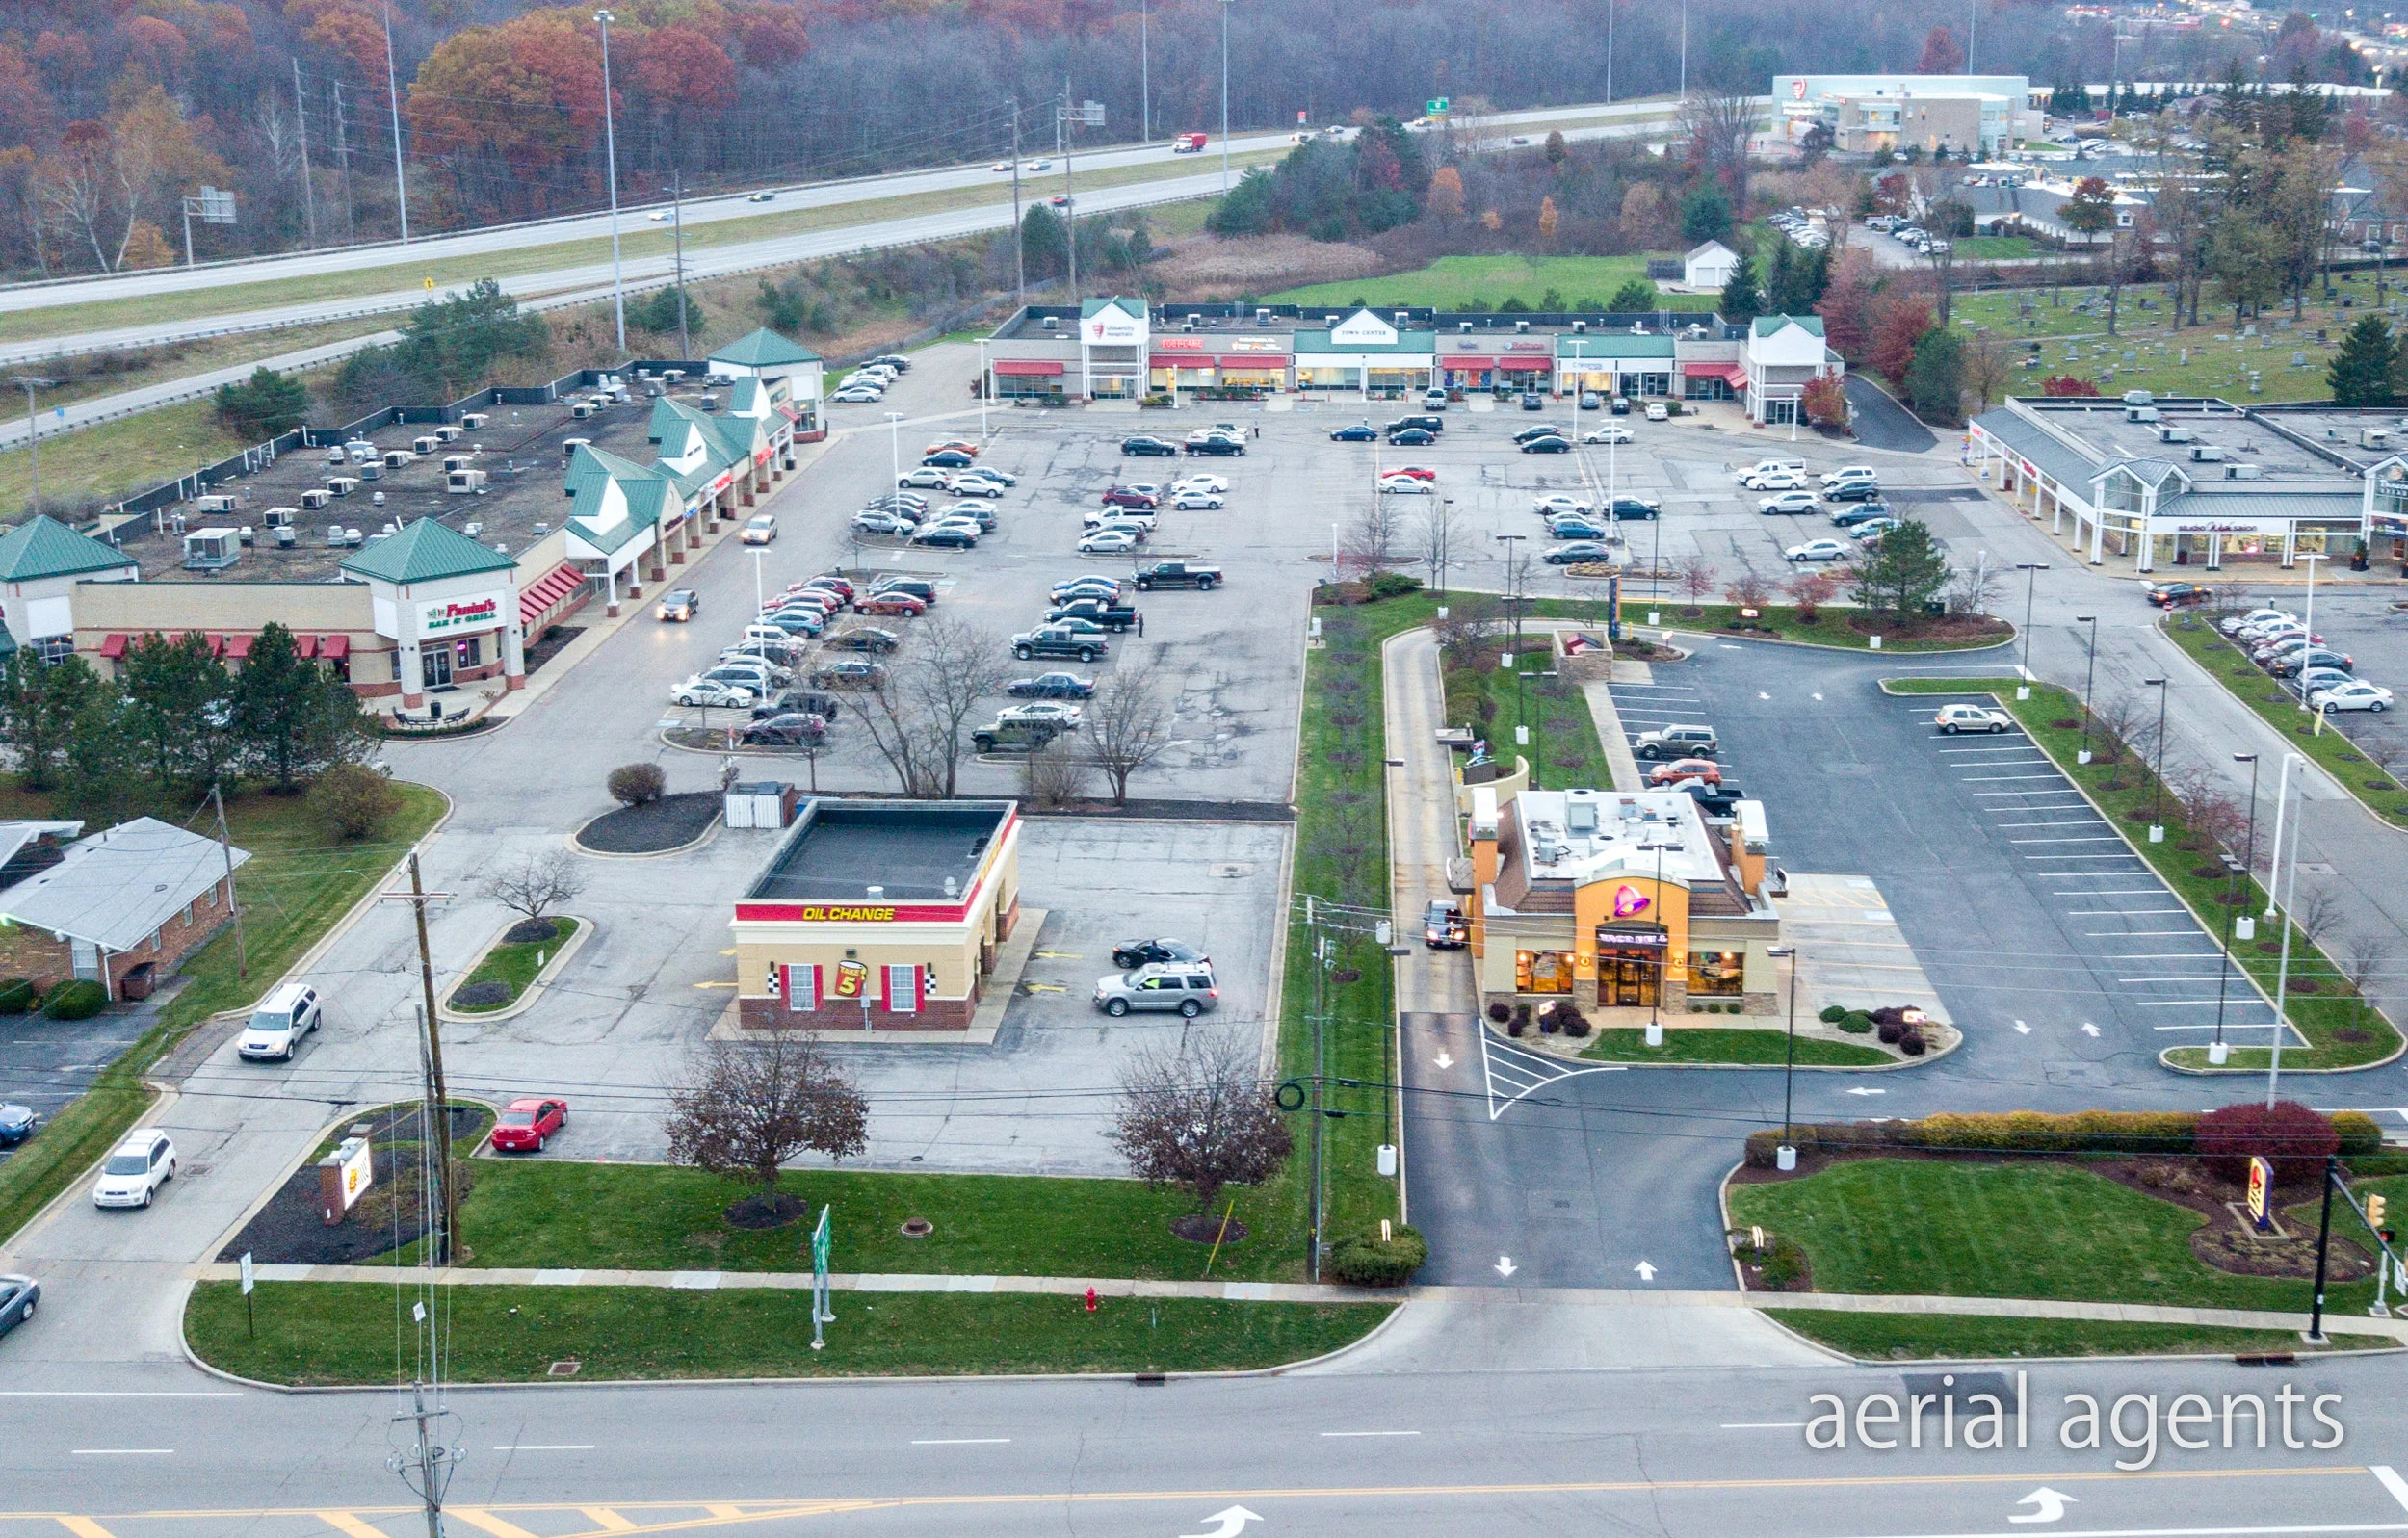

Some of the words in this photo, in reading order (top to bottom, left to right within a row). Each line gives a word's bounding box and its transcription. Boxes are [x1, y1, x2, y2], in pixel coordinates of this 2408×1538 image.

[429, 619, 449, 629] BAR
[465, 612, 497, 623] GRILL
[803, 907, 827, 921] OIL
[829, 907, 895, 921] CHANGE
[1599, 933, 1634, 943] TACO
[839, 976, 856, 995] 5
